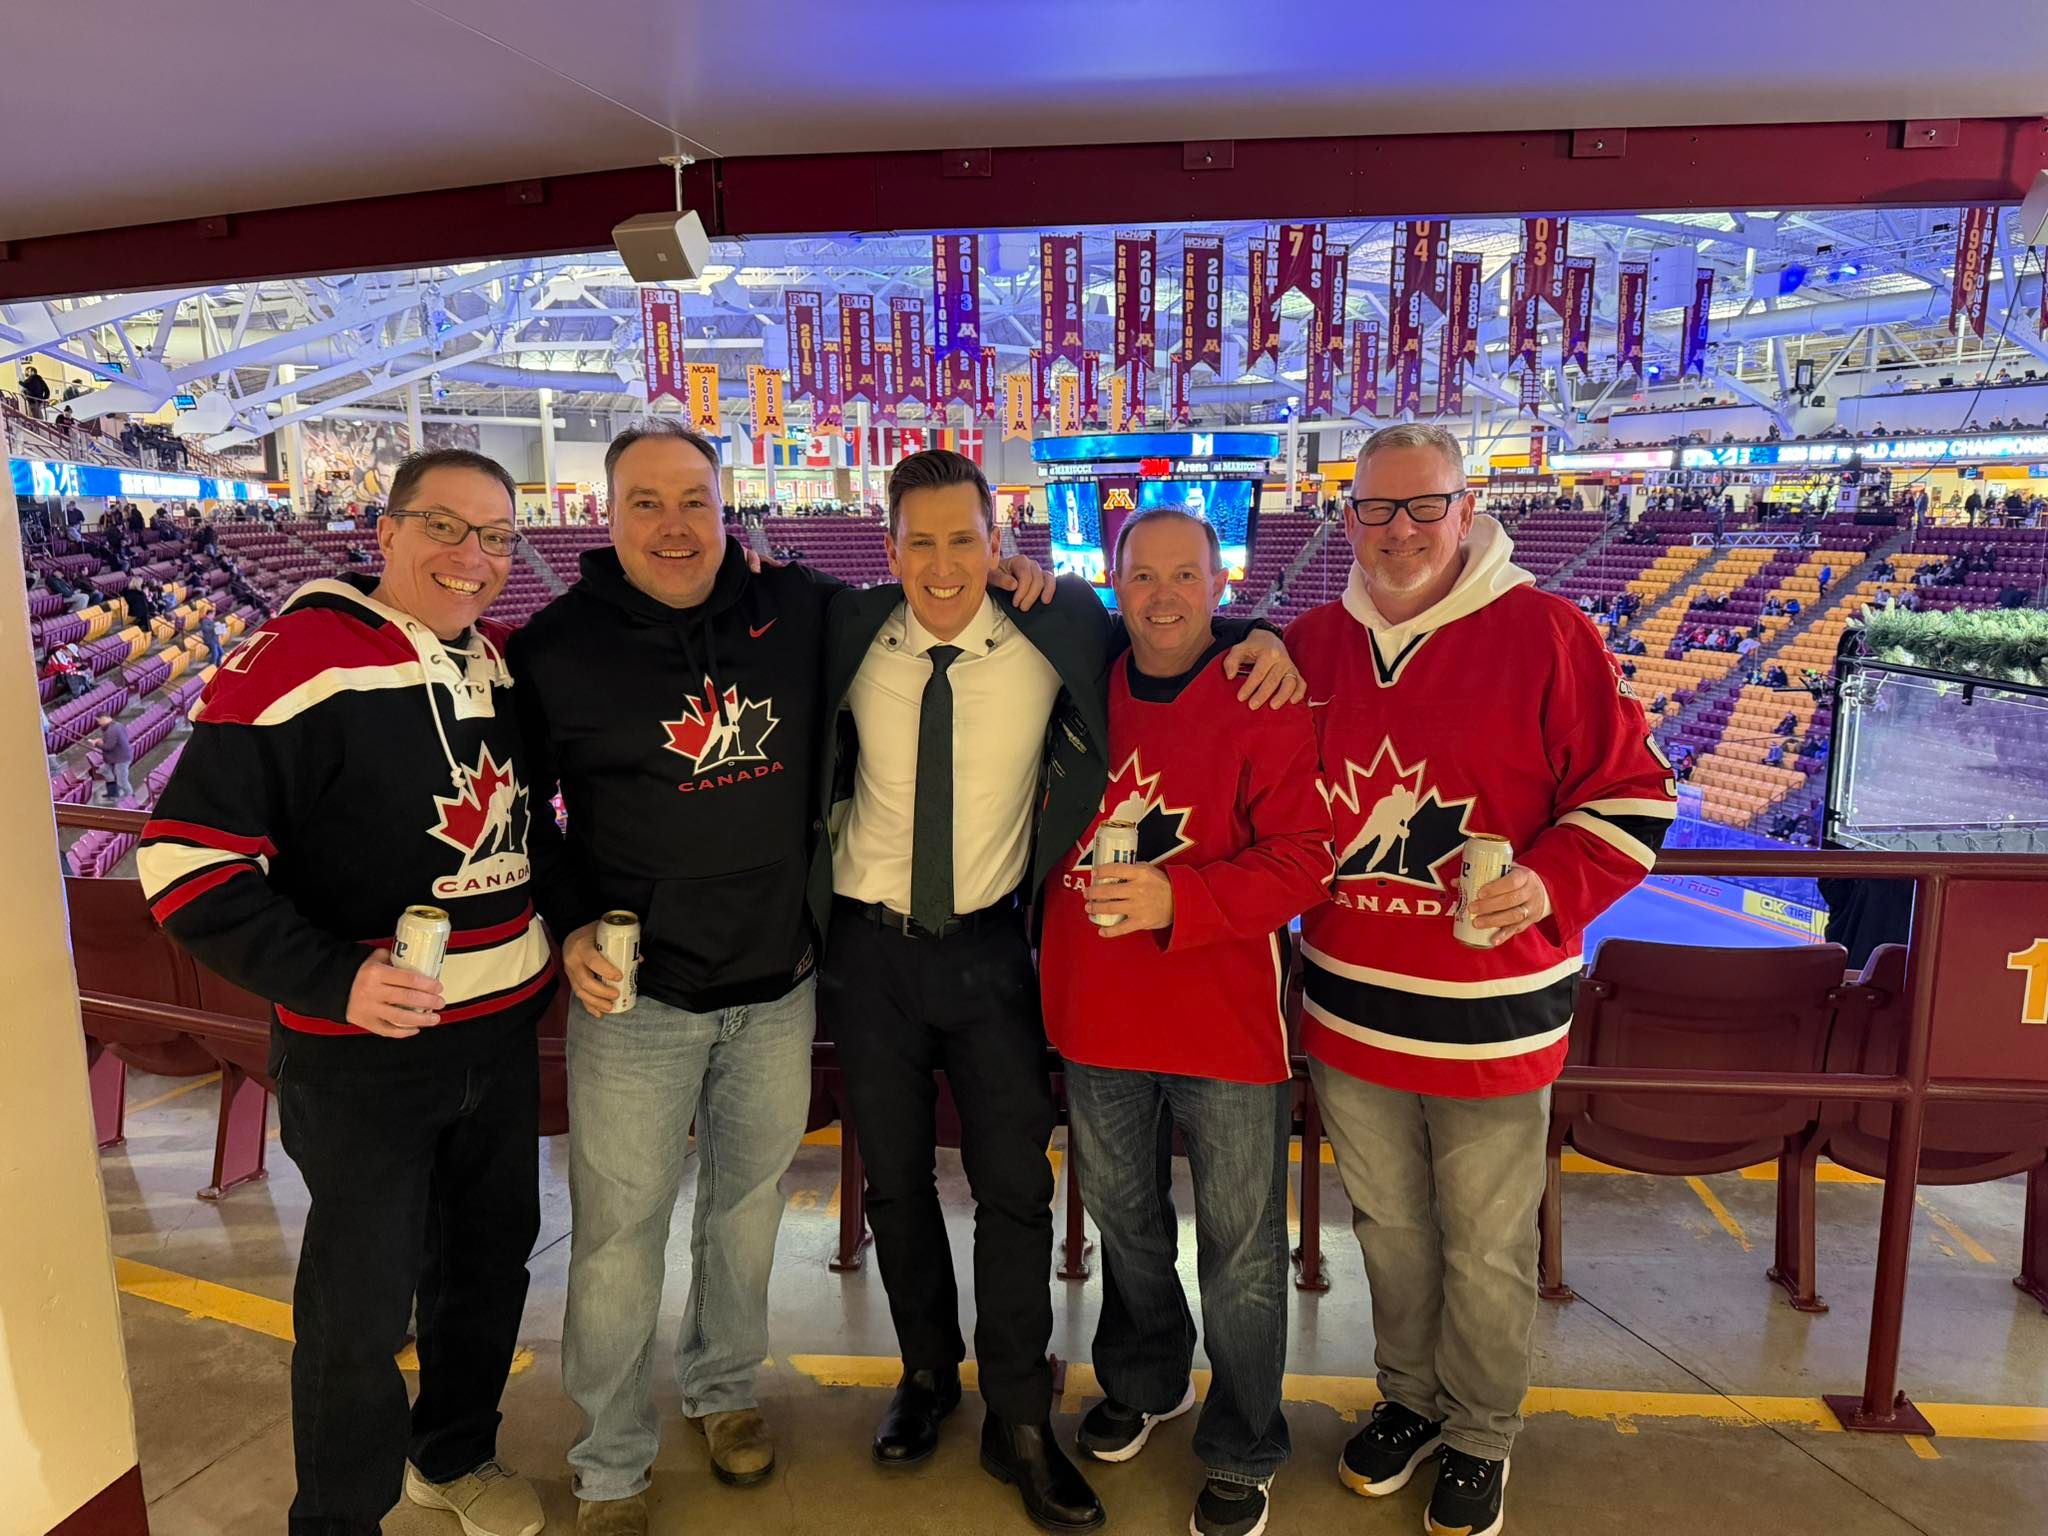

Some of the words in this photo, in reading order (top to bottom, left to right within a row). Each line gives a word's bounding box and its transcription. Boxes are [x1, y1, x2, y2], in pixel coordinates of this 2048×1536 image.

[1533, 217, 1549, 267] 03
[959, 237, 973, 312] 2013
[1043, 242, 1053, 355] CHAMPIONS
[1065, 247, 1077, 320] 2012
[1117, 244, 1127, 356] CHAMPIONS
[1140, 250, 1152, 322] 2007
[1206, 258, 1219, 328] 2006
[1252, 252, 1262, 351] CHAMPIONS
[1331, 260, 1344, 326] 1992
[1467, 268, 1479, 329] 1988
[1579, 272, 1591, 332] 1981
[1184, 252, 1195, 361] CHAMPIONS
[1452, 265, 1463, 356] CHAMPIONS
[1563, 269, 1575, 358] CHAMPIONS
[1632, 278, 1643, 336] 1975
[644, 304, 658, 392] TOURNAMENT
[656, 321, 670, 376] 2021
[669, 304, 682, 389] CHAMPIONS
[789, 306, 801, 392] TOURNAMENT
[800, 323, 812, 376] 2015
[812, 307, 823, 389] CHAMPIONS
[842, 308, 853, 391] CHAMPIONS
[859, 311, 871, 366] 2025
[893, 311, 904, 394] CHAMPIONS
[910, 315, 921, 368] 2023
[1366, 335, 1377, 383] 2016
[691, 365, 716, 375] NCAA
[701, 376, 711, 412] 2003
[756, 367, 781, 376] NCAA
[766, 377, 774, 413] 2002
[828, 353, 838, 395] 2023
[883, 353, 893, 395] 2014
[1352, 332, 1361, 406] CHAMPIONS
[749, 367, 759, 432] CHAMPIONS
[1139, 459, 1172, 476] 3M
[1175, 460, 1210, 473] Arena
[1103, 488, 1136, 510] M
[678, 761, 784, 792] CANADA
[437, 863, 530, 893] CANADA
[1334, 890, 1458, 917] ANAD
[1759, 896, 1787, 914] OK
[1788, 906, 1813, 924] TIRE
